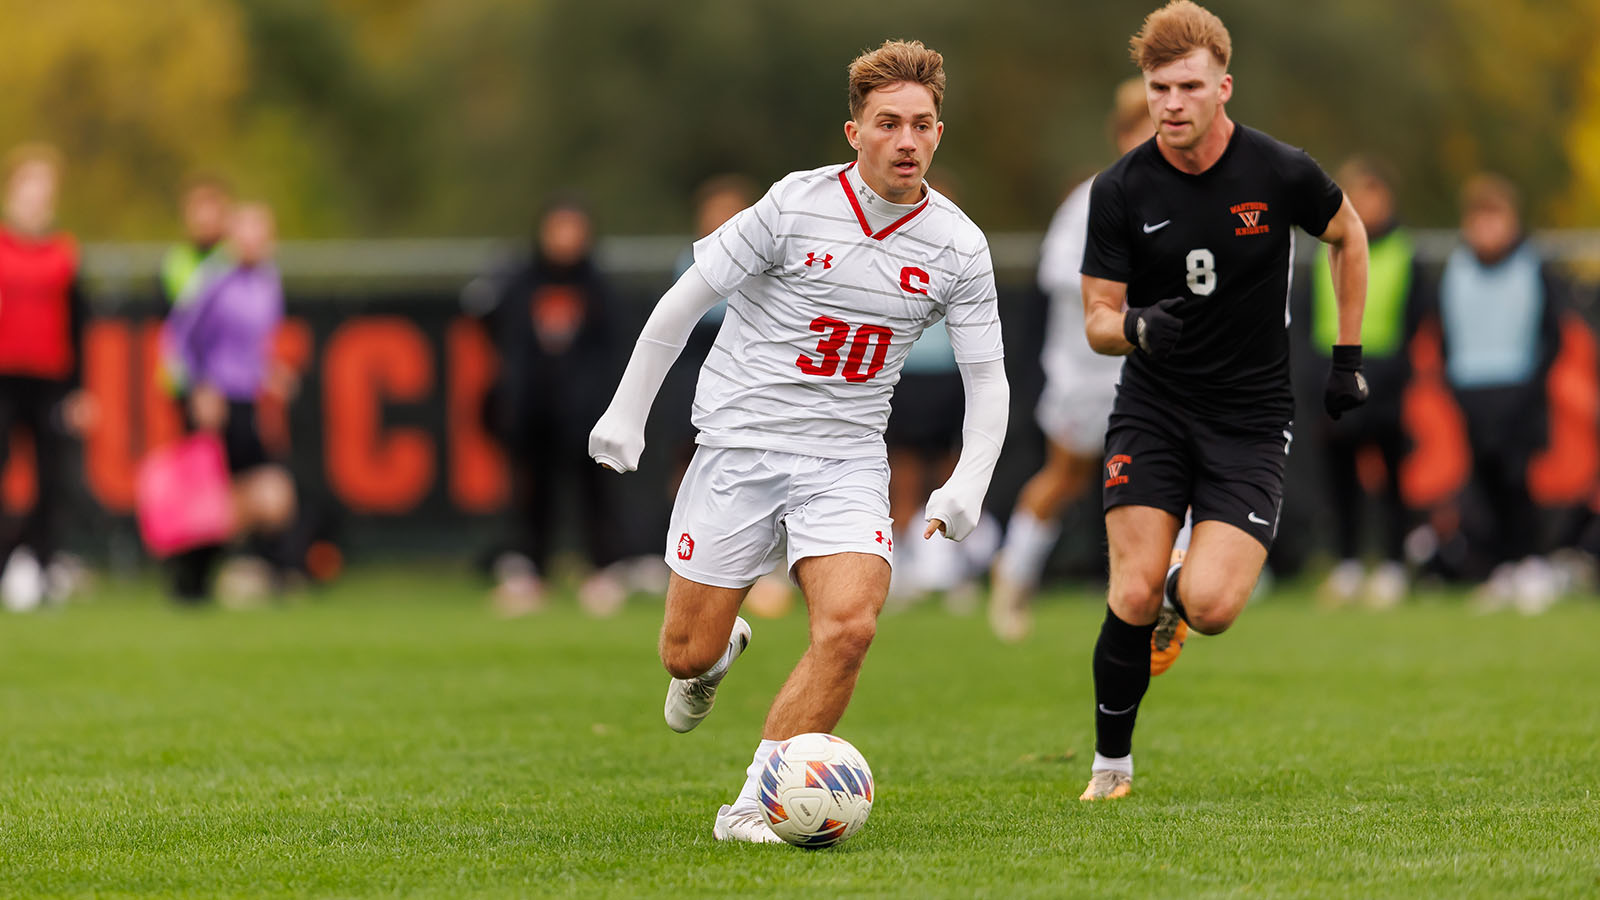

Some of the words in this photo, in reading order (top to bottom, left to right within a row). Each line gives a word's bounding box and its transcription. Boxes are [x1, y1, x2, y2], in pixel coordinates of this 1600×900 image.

[1238, 210, 1260, 228] W
[900, 266, 930, 296] C
[1186, 248, 1217, 297] 8
[795, 315, 894, 383] 30
